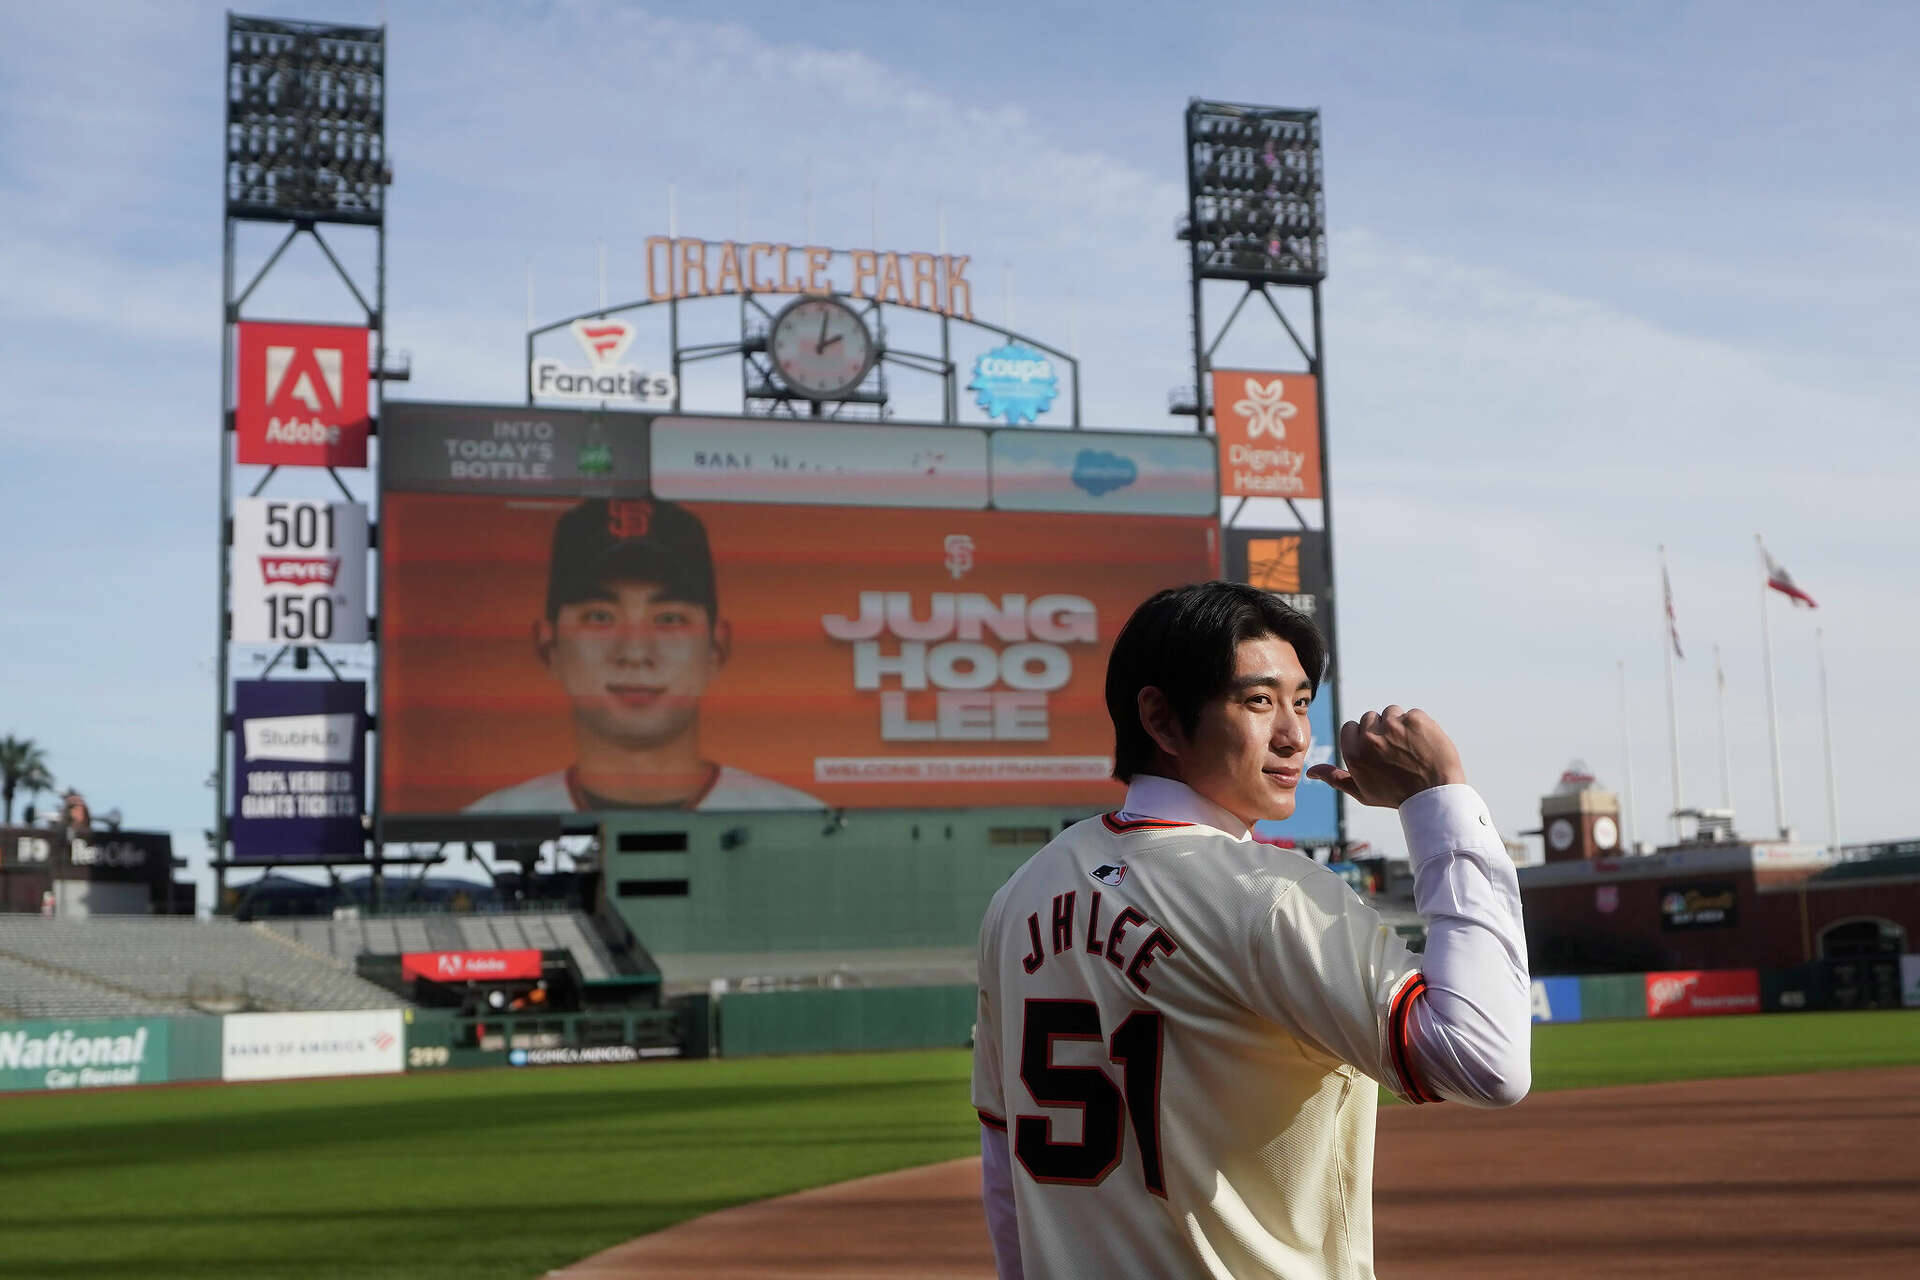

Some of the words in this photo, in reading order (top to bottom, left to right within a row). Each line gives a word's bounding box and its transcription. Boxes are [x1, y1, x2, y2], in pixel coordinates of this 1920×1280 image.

[645, 236, 832, 301] ORACLE
[852, 248, 974, 321] PARK
[538, 365, 669, 398] Fanatics
[265, 416, 341, 445] Adobe
[493, 421, 553, 438] INTO
[444, 440, 553, 461] TODAY'S
[1229, 444, 1305, 472] Dignity
[1233, 470, 1305, 494] Health
[266, 504, 335, 549] 501
[264, 594, 333, 640] 150
[821, 591, 1099, 642] JUNG
[853, 641, 1073, 692] HOO
[880, 691, 1050, 741] LEE
[823, 763, 919, 777] WELCOME
[928, 763, 952, 776] TO
[956, 763, 993, 776] SAN
[0, 1026, 147, 1070] National
[45, 1069, 78, 1089] Car
[1015, 998, 1167, 1200] 51
